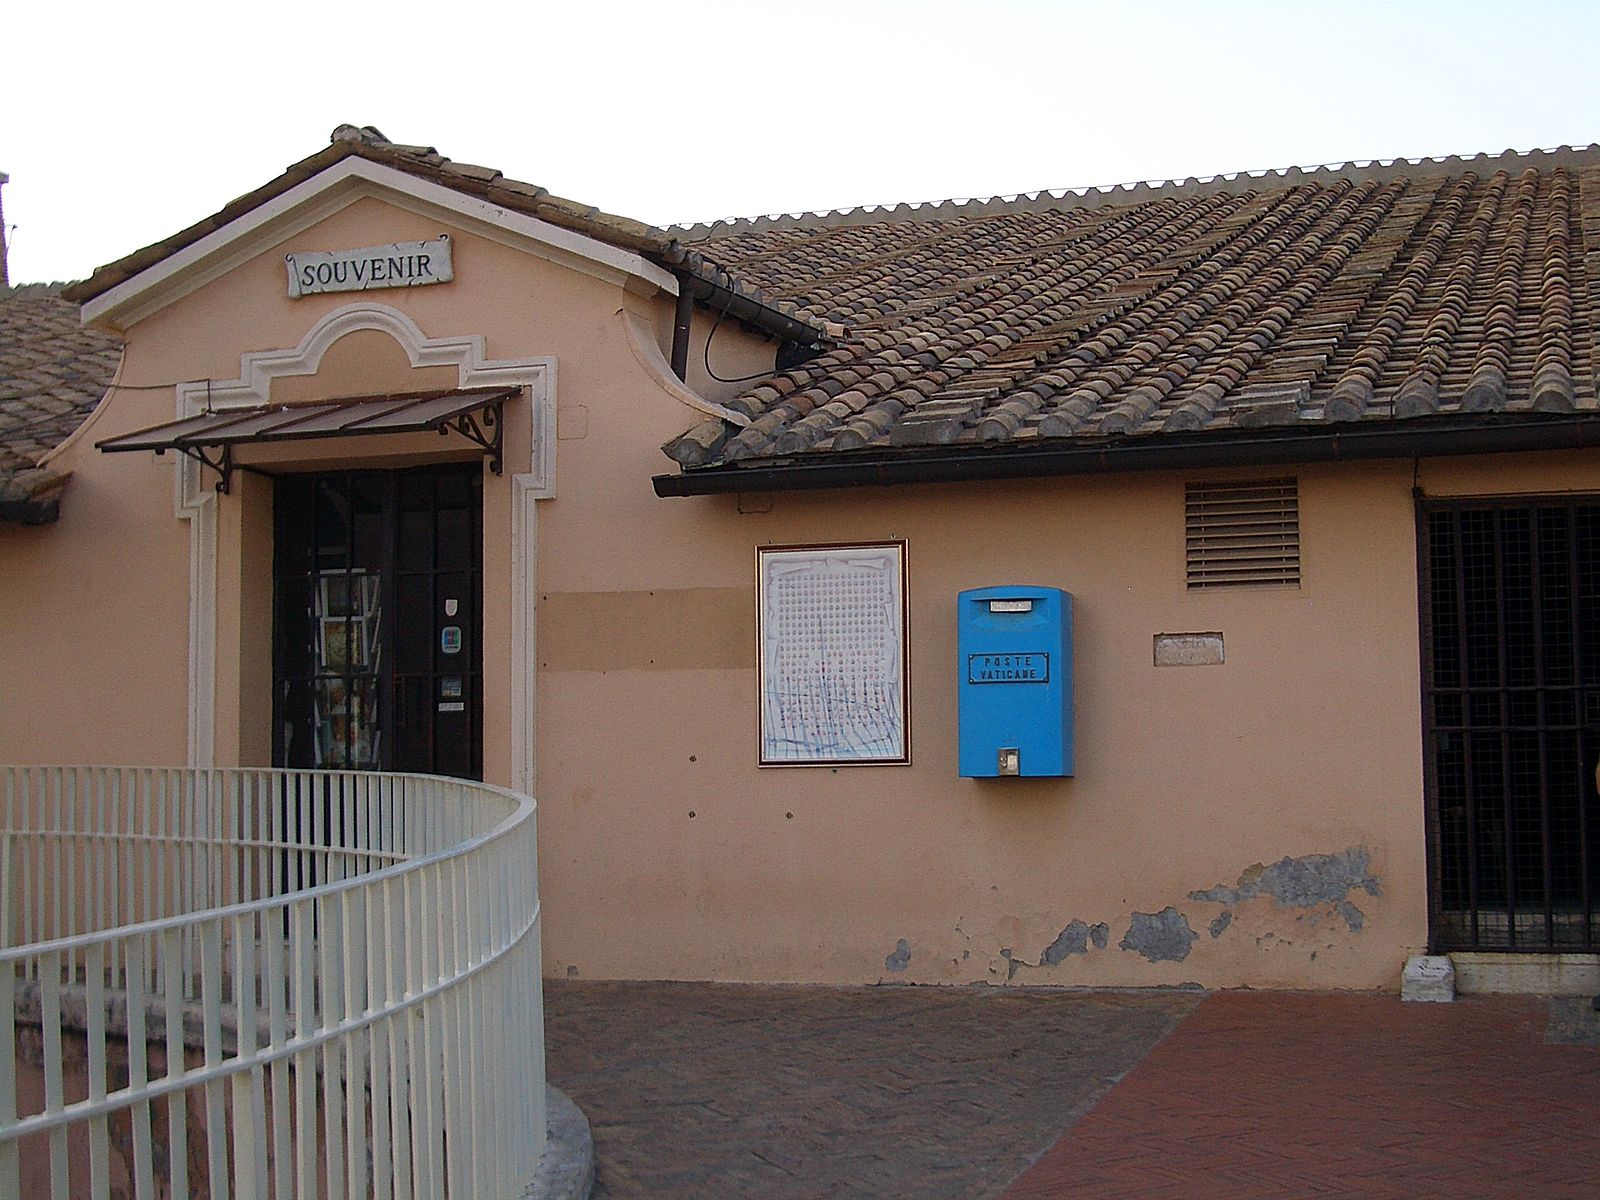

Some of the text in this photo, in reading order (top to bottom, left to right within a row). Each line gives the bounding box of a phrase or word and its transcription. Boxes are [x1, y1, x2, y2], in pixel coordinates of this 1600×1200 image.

[302, 255, 433, 287] SOUVENIR
[984, 656, 1032, 667] POSTE
[980, 669, 1037, 680] VATICANE
